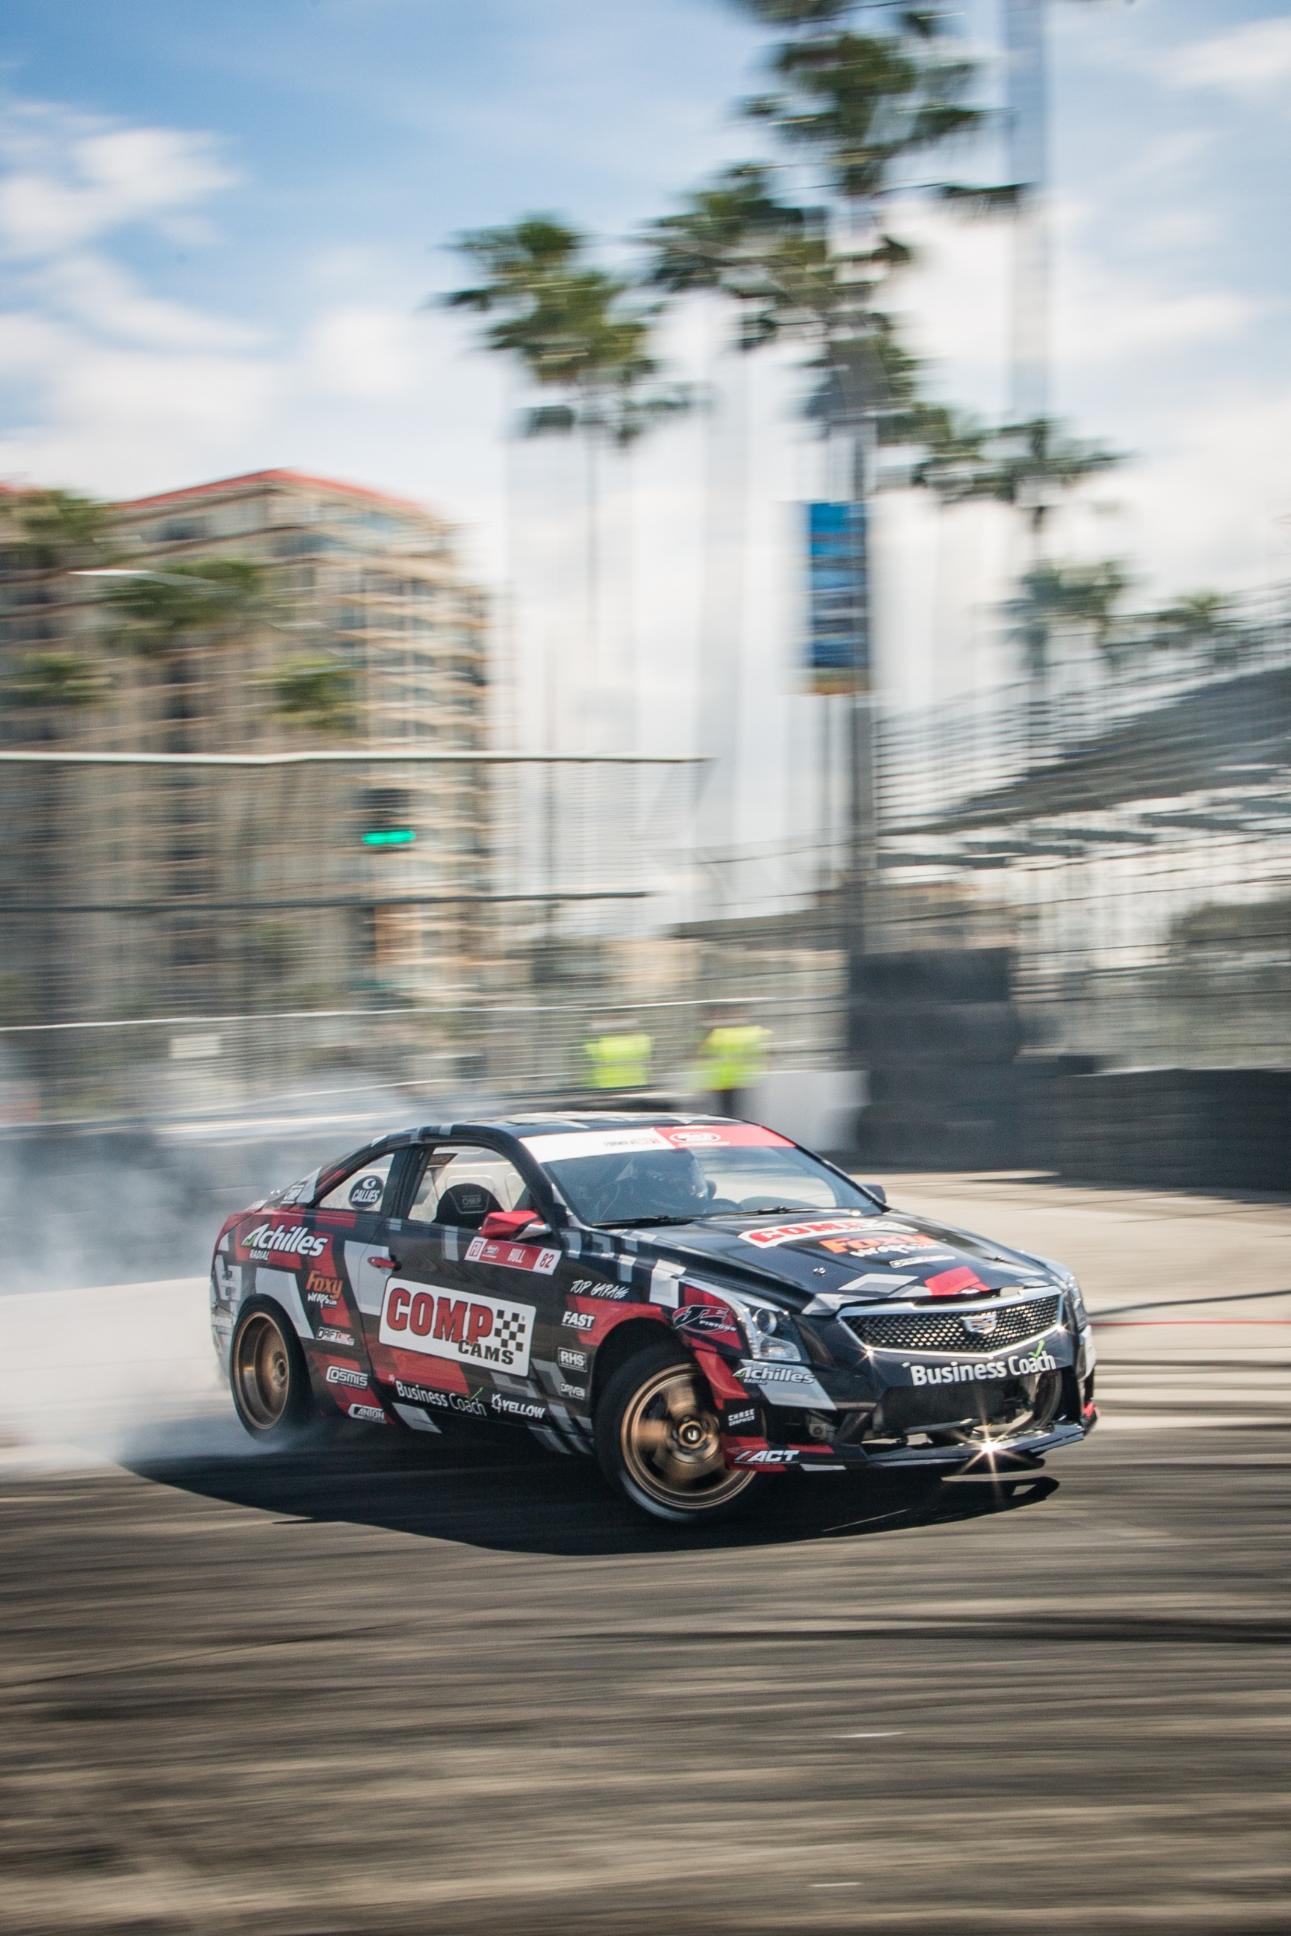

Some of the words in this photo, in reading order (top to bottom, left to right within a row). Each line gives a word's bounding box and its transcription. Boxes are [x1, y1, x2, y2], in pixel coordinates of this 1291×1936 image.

[241, 1222, 329, 1258] Achilles
[539, 1252, 555, 1269] 82
[386, 1287, 494, 1344] COMP
[562, 1311, 596, 1328] FAST
[458, 1339, 515, 1366] CAMS
[560, 1350, 585, 1367] RHS
[732, 1366, 816, 1384] Achilles
[909, 1361, 1007, 1386] Business
[1007, 1350, 1056, 1376] Coach
[395, 1379, 448, 1408] Business
[449, 1391, 488, 1417] Coach
[747, 1450, 800, 1462] ACT
